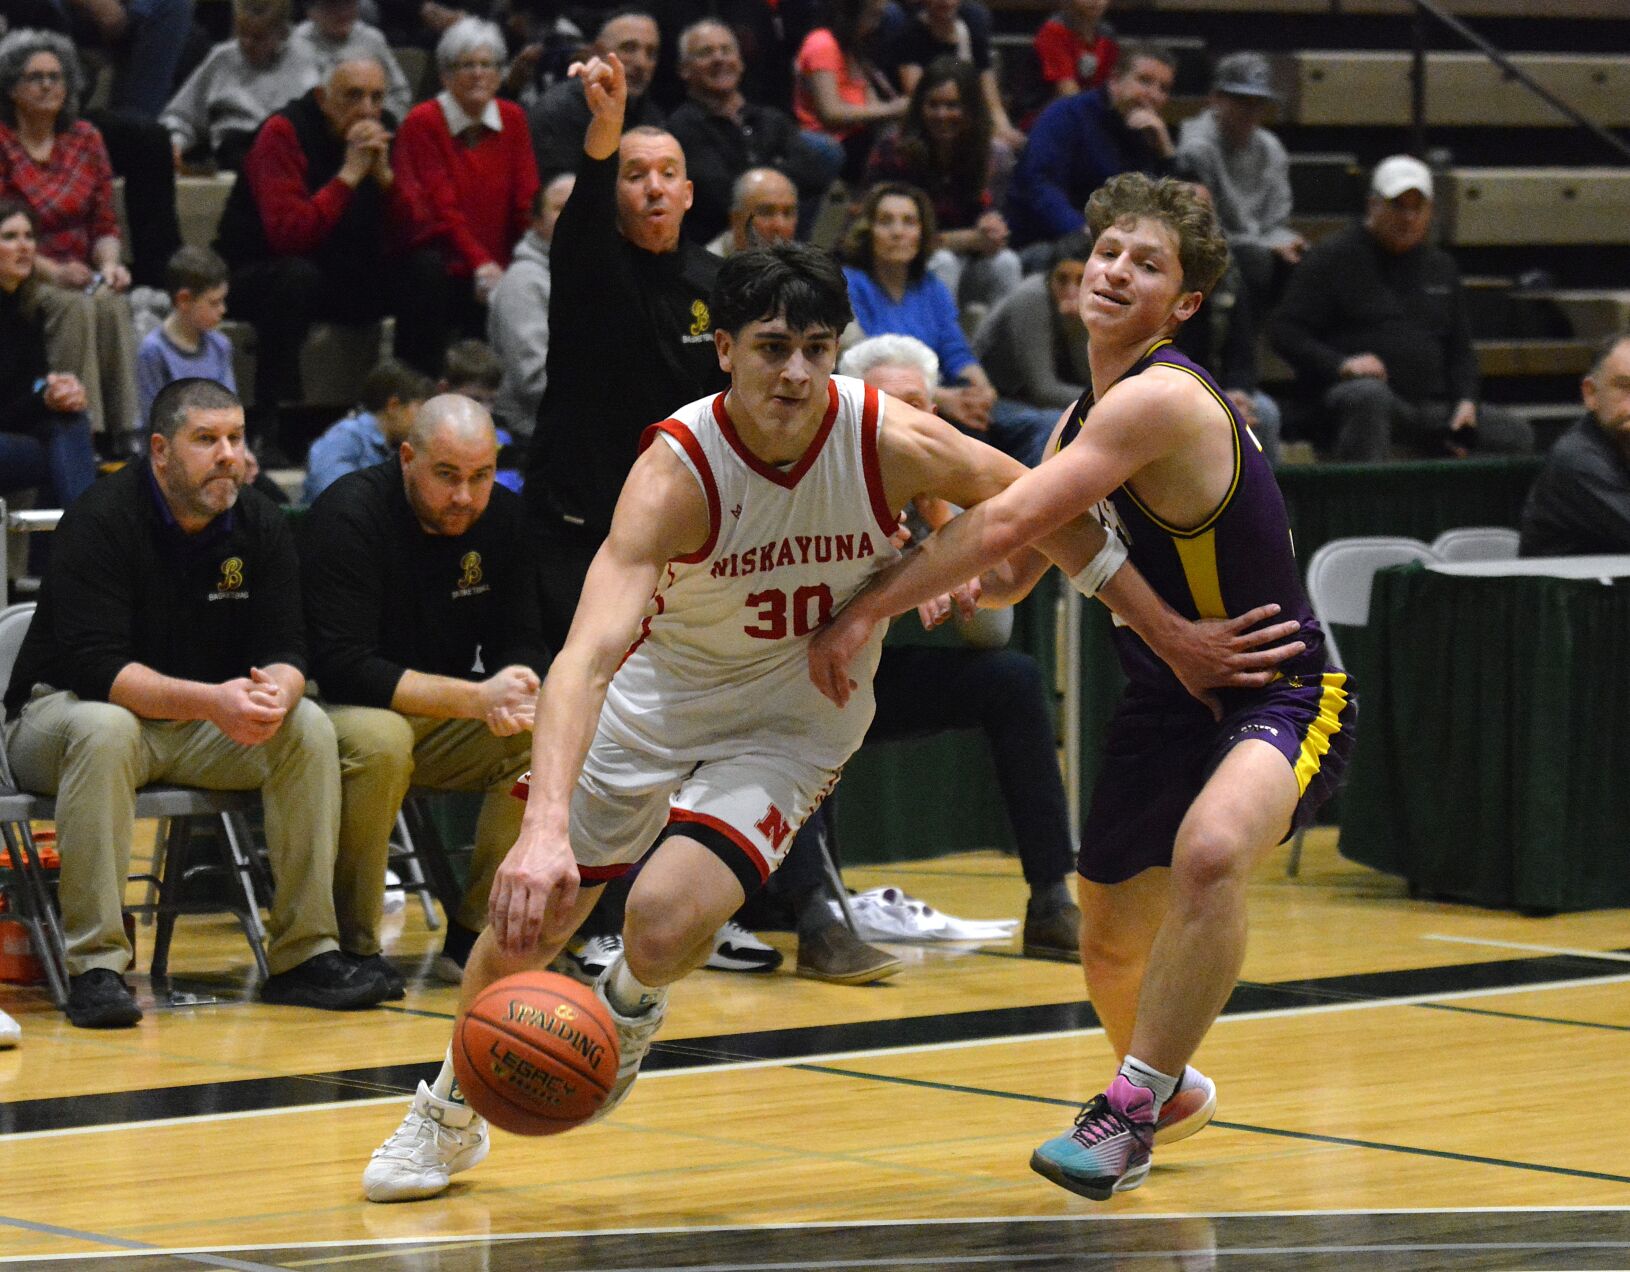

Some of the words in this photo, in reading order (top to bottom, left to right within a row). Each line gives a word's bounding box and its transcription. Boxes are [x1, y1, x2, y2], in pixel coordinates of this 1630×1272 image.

[710, 532, 874, 579] NISKAYUNA
[744, 582, 834, 640] 30
[754, 802, 792, 854] N
[503, 1000, 605, 1070] SPALDING
[490, 1040, 576, 1096] LEGACY
